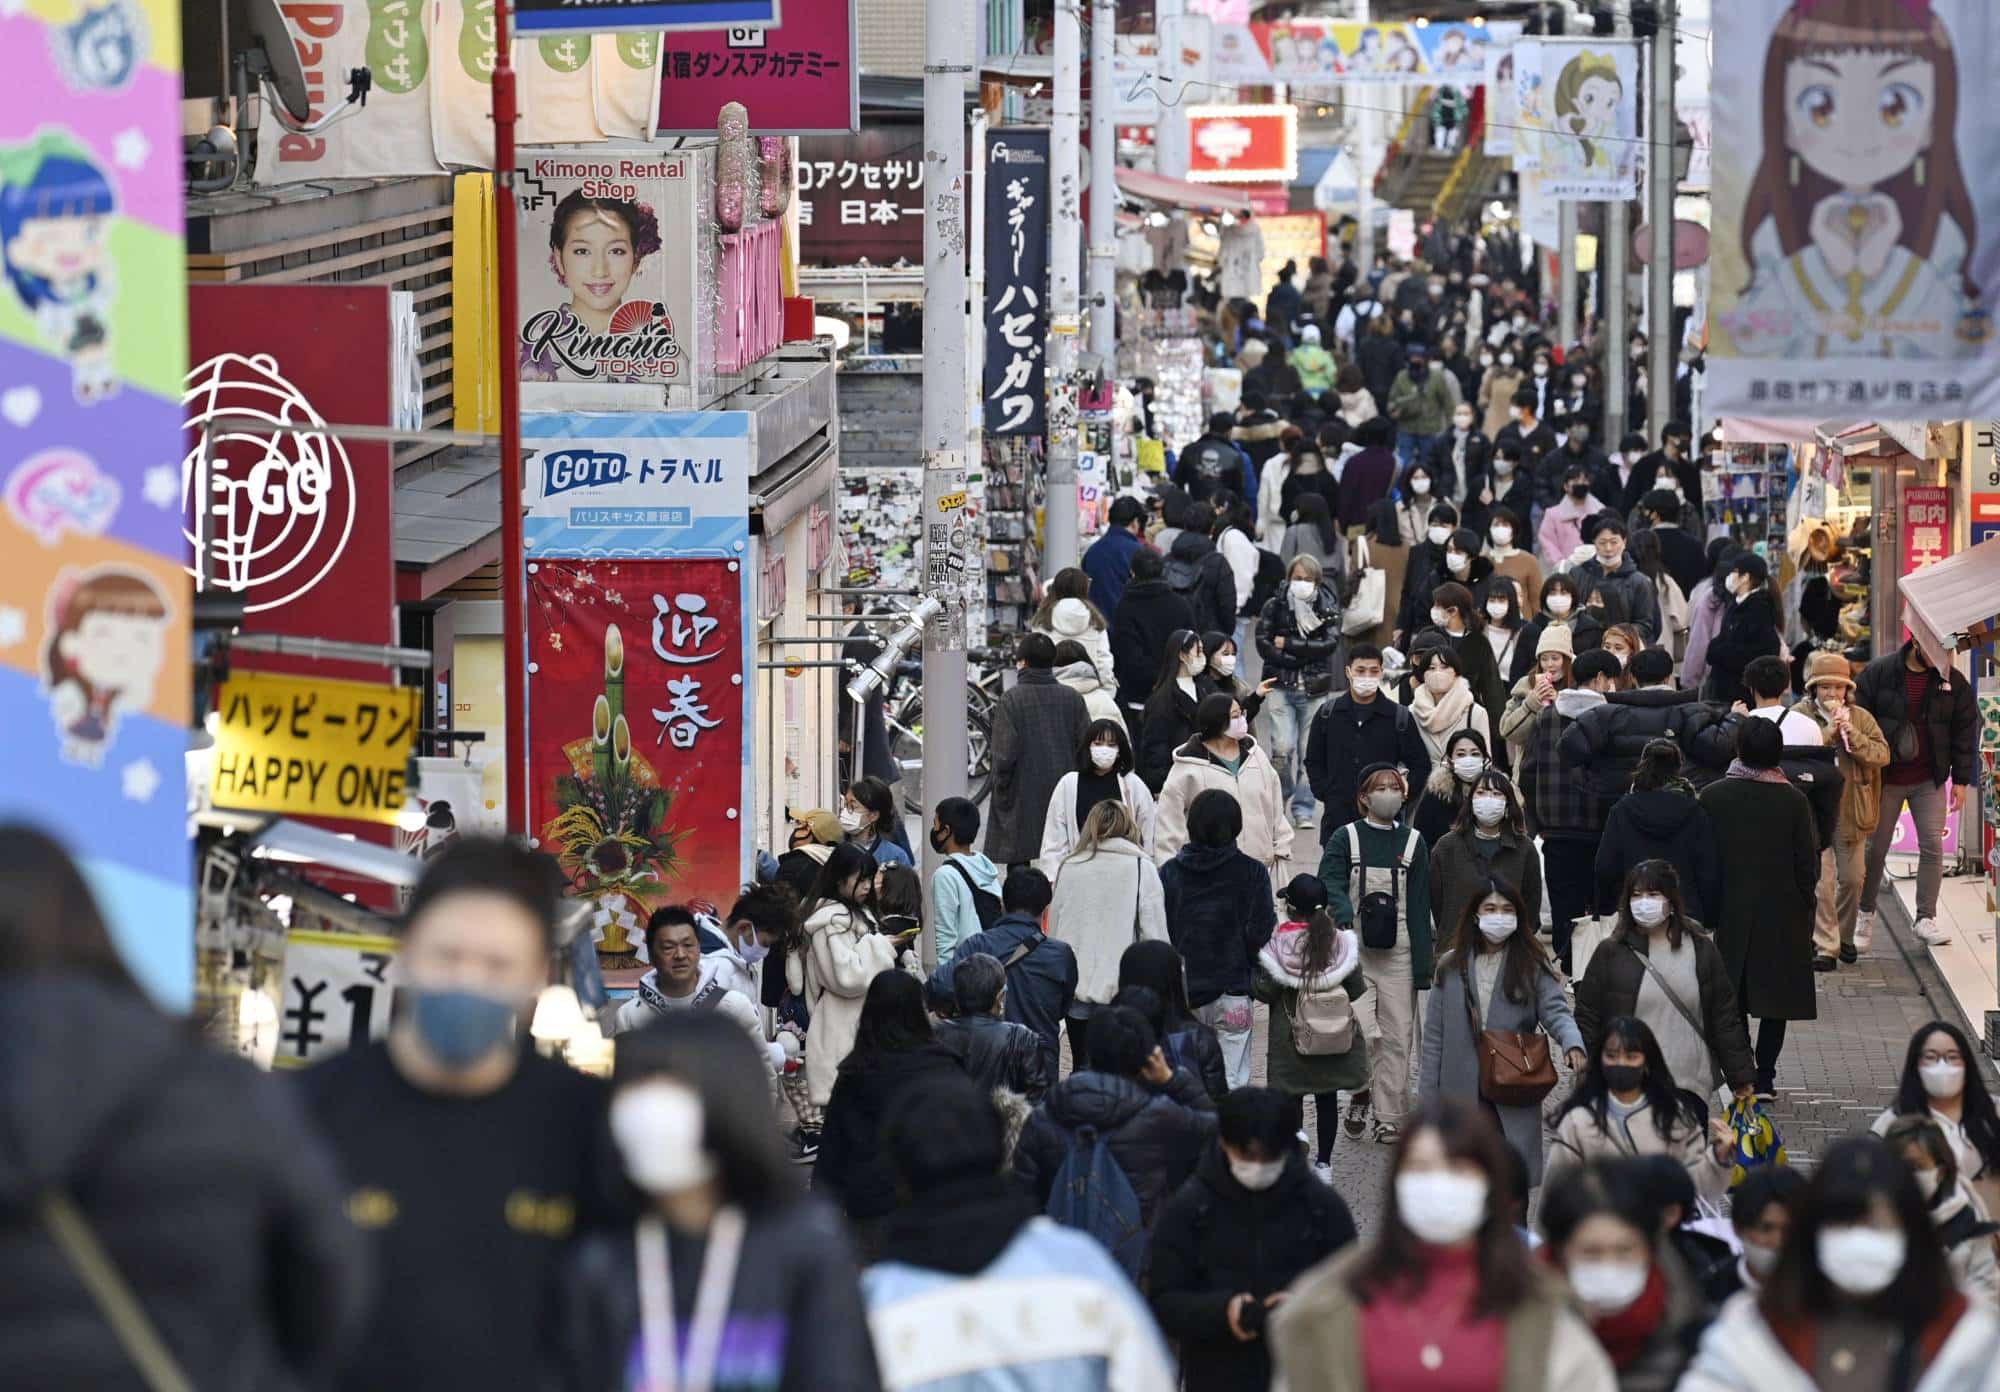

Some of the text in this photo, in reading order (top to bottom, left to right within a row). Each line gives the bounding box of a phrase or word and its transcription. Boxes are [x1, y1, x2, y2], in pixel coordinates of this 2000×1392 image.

[535, 159, 685, 178] Kimono Rental
[582, 180, 636, 201] Shop
[840, 200, 925, 225] 日本一
[523, 311, 677, 376] Kimono
[595, 360, 677, 376] TOKYO
[551, 454, 724, 489] GOTO トラベル
[1907, 504, 1946, 524] 都内
[652, 592, 726, 748] 迎春
[225, 692, 414, 748] ハッピーワン
[215, 752, 405, 809] HAPPY ONE
